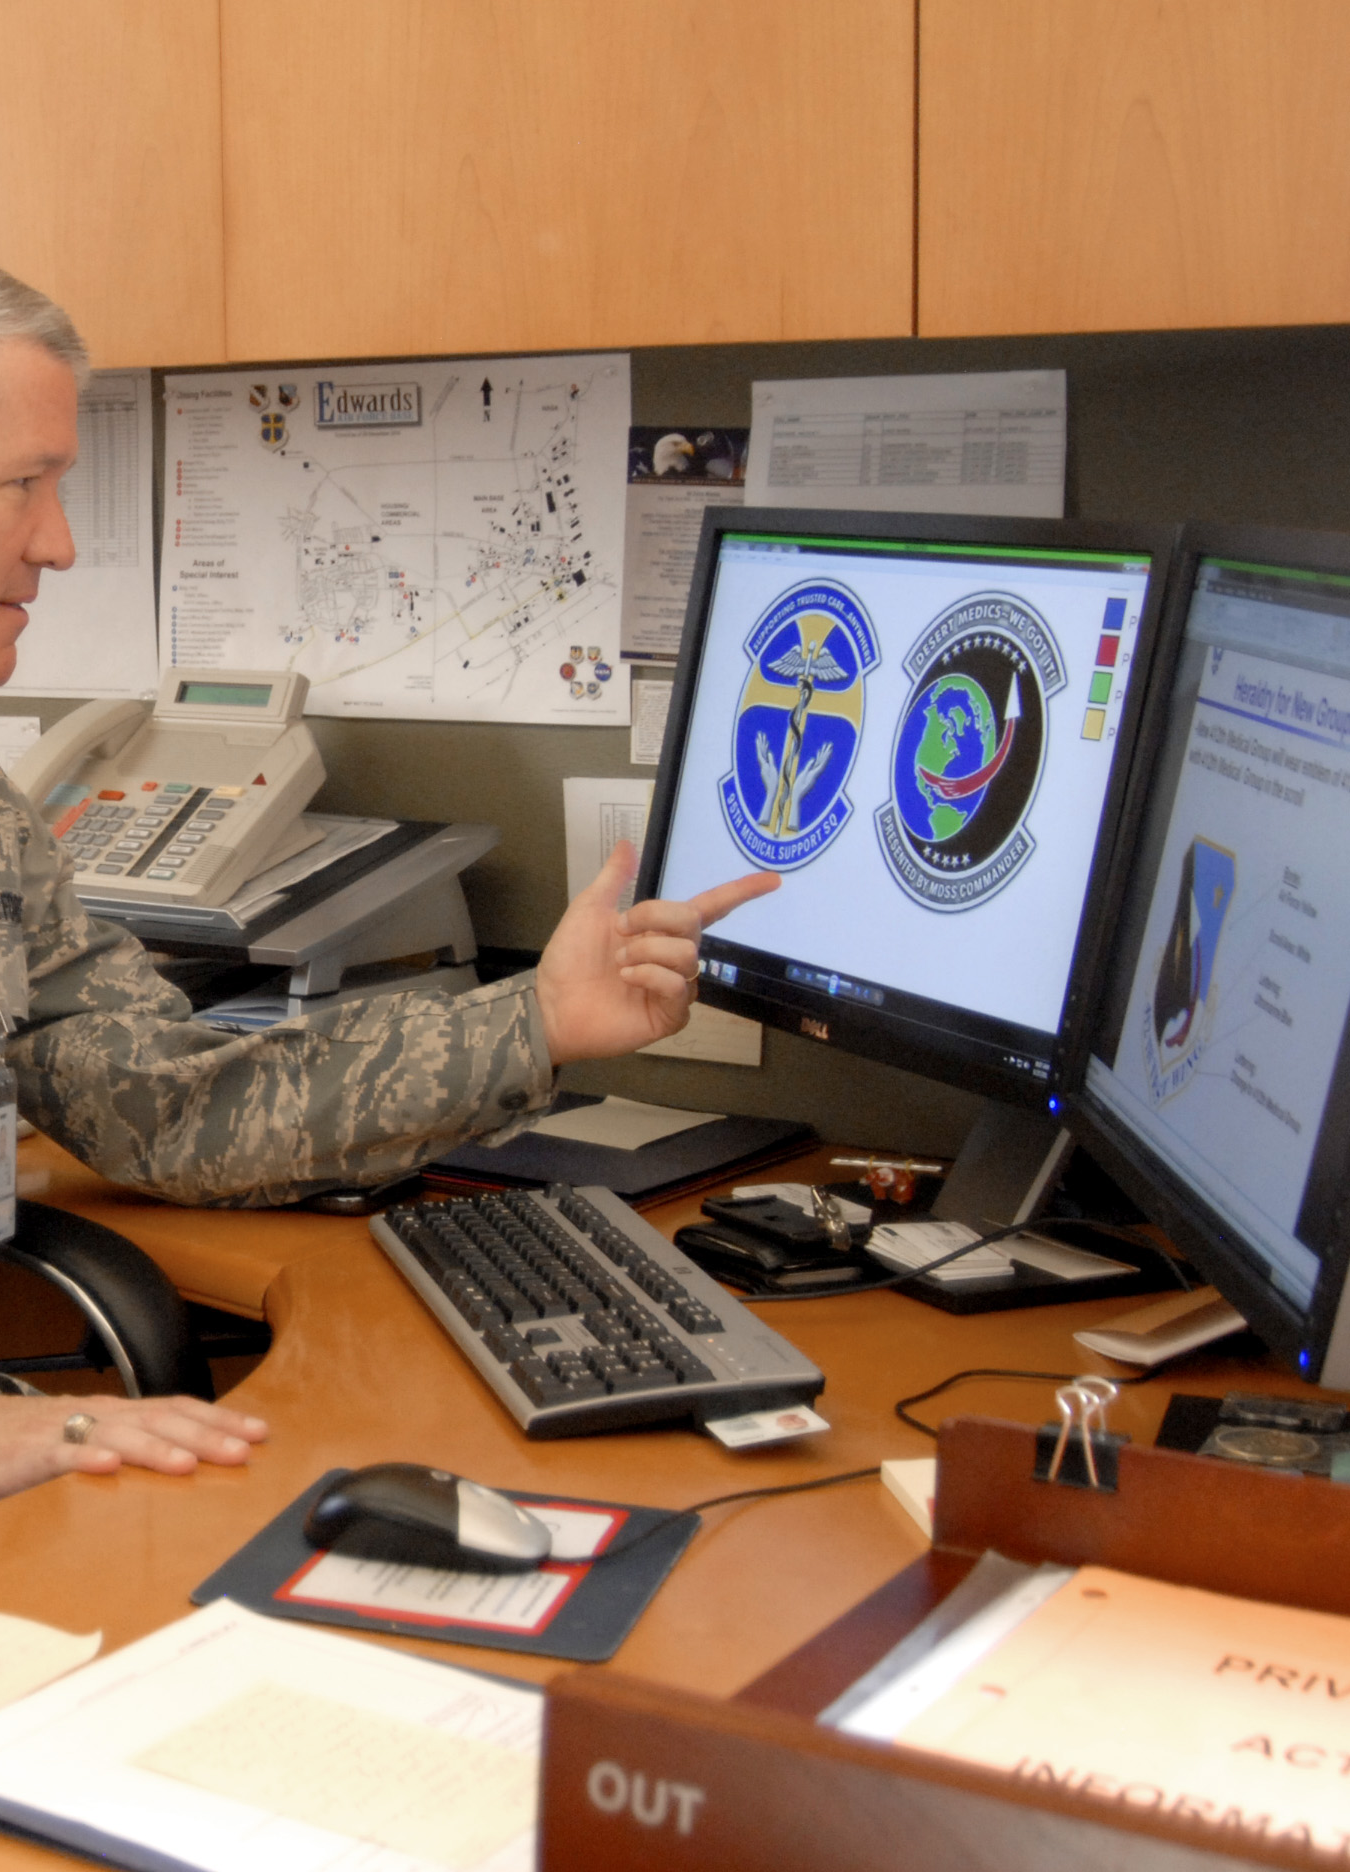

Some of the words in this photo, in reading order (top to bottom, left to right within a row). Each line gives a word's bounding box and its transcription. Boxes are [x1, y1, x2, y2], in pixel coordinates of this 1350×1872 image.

[317, 381, 413, 423] Edwards
[483, 409, 491, 422] N
[179, 570, 208, 580] Special
[209, 570, 240, 580] Interest
[192, 559, 214, 568] Areas
[216, 559, 226, 568] of
[752, 601, 797, 652] SUPPORTING
[797, 593, 828, 608] TRUSTED
[915, 618, 954, 667] DESERT
[1026, 625, 1048, 656] GOT
[740, 824, 776, 860] MEDICAL
[778, 829, 822, 860] SUPPORT
[822, 813, 839, 836] SQ
[883, 813, 917, 882] PRESENTED
[916, 874, 931, 891] BY
[930, 883, 959, 900] MDSS
[959, 839, 1026, 898] COMMANDER
[586, 1760, 707, 1837] OUT
